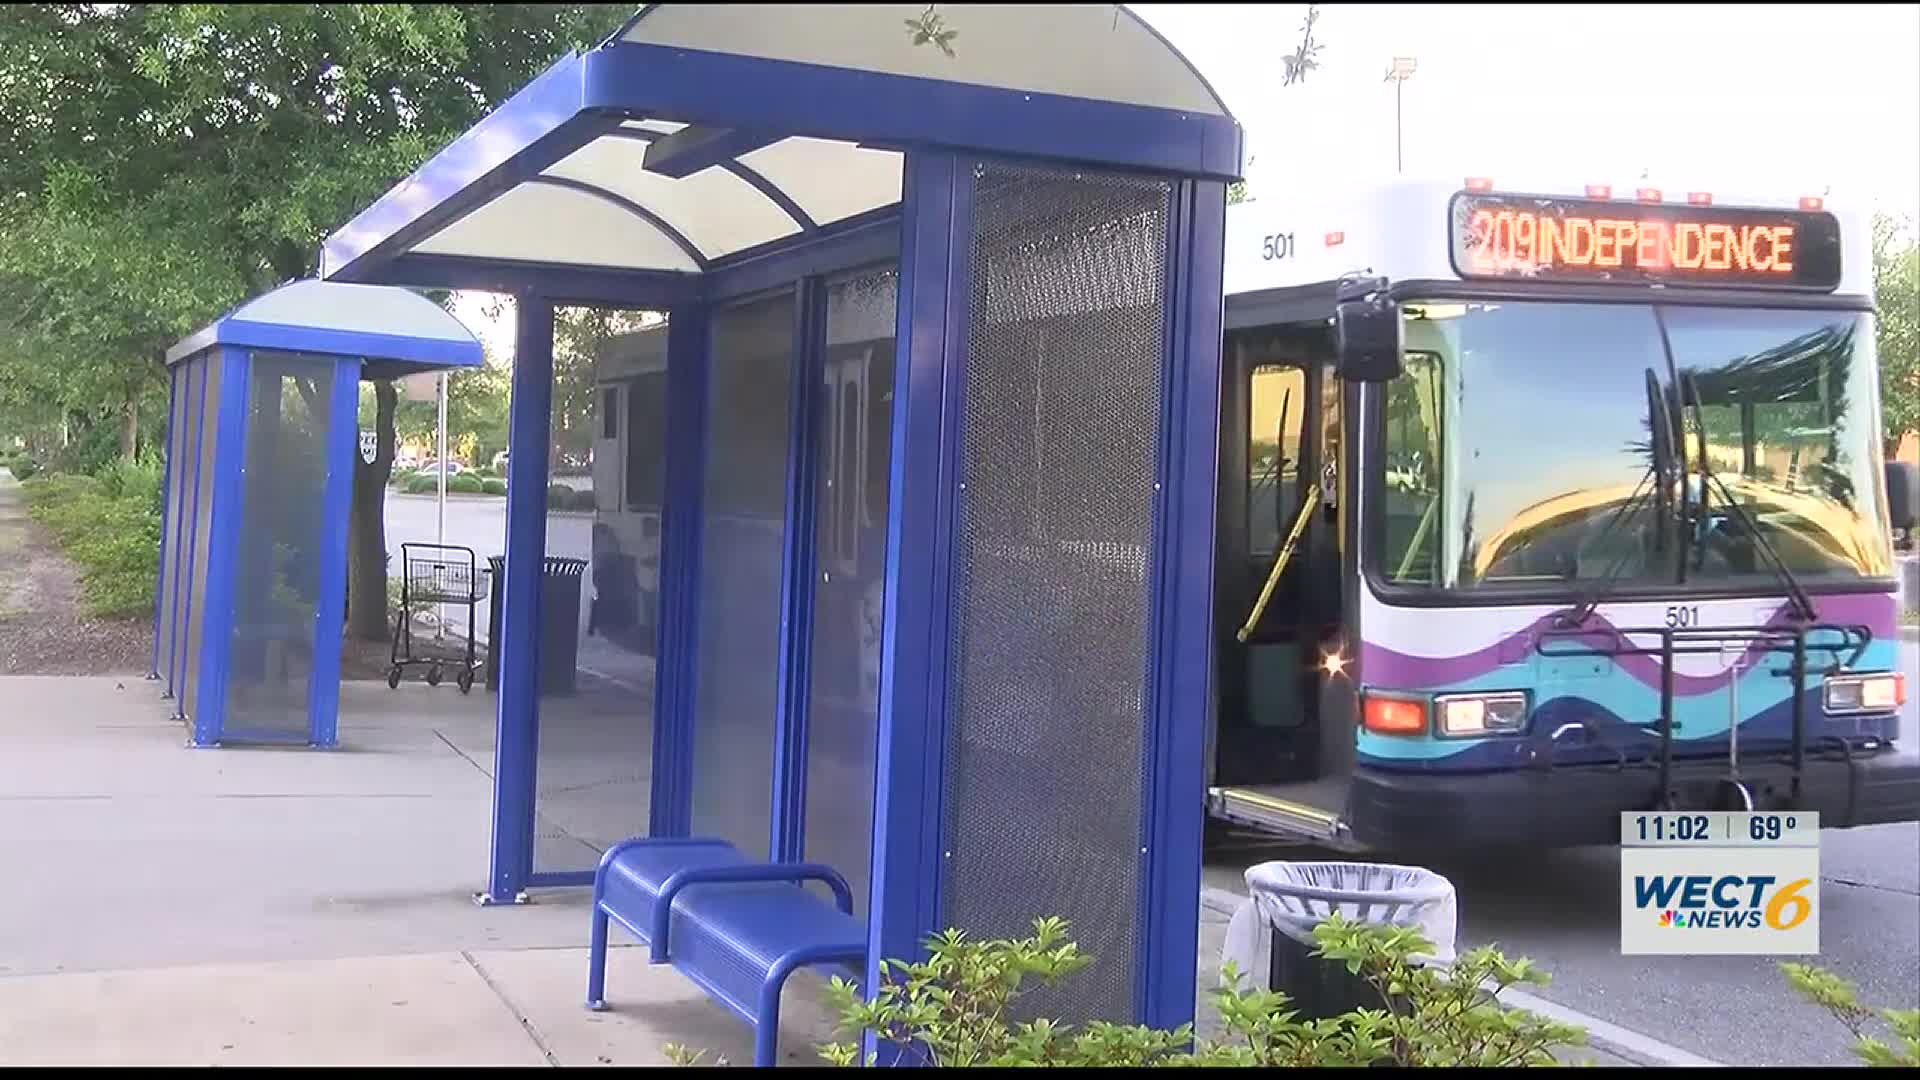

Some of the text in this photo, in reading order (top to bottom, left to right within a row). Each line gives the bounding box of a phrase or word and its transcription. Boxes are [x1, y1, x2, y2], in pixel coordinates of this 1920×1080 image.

[1263, 231, 1295, 261] 501
[1471, 210, 1793, 272] 209 INDEPENDENCE
[1665, 606, 1698, 628] 501
